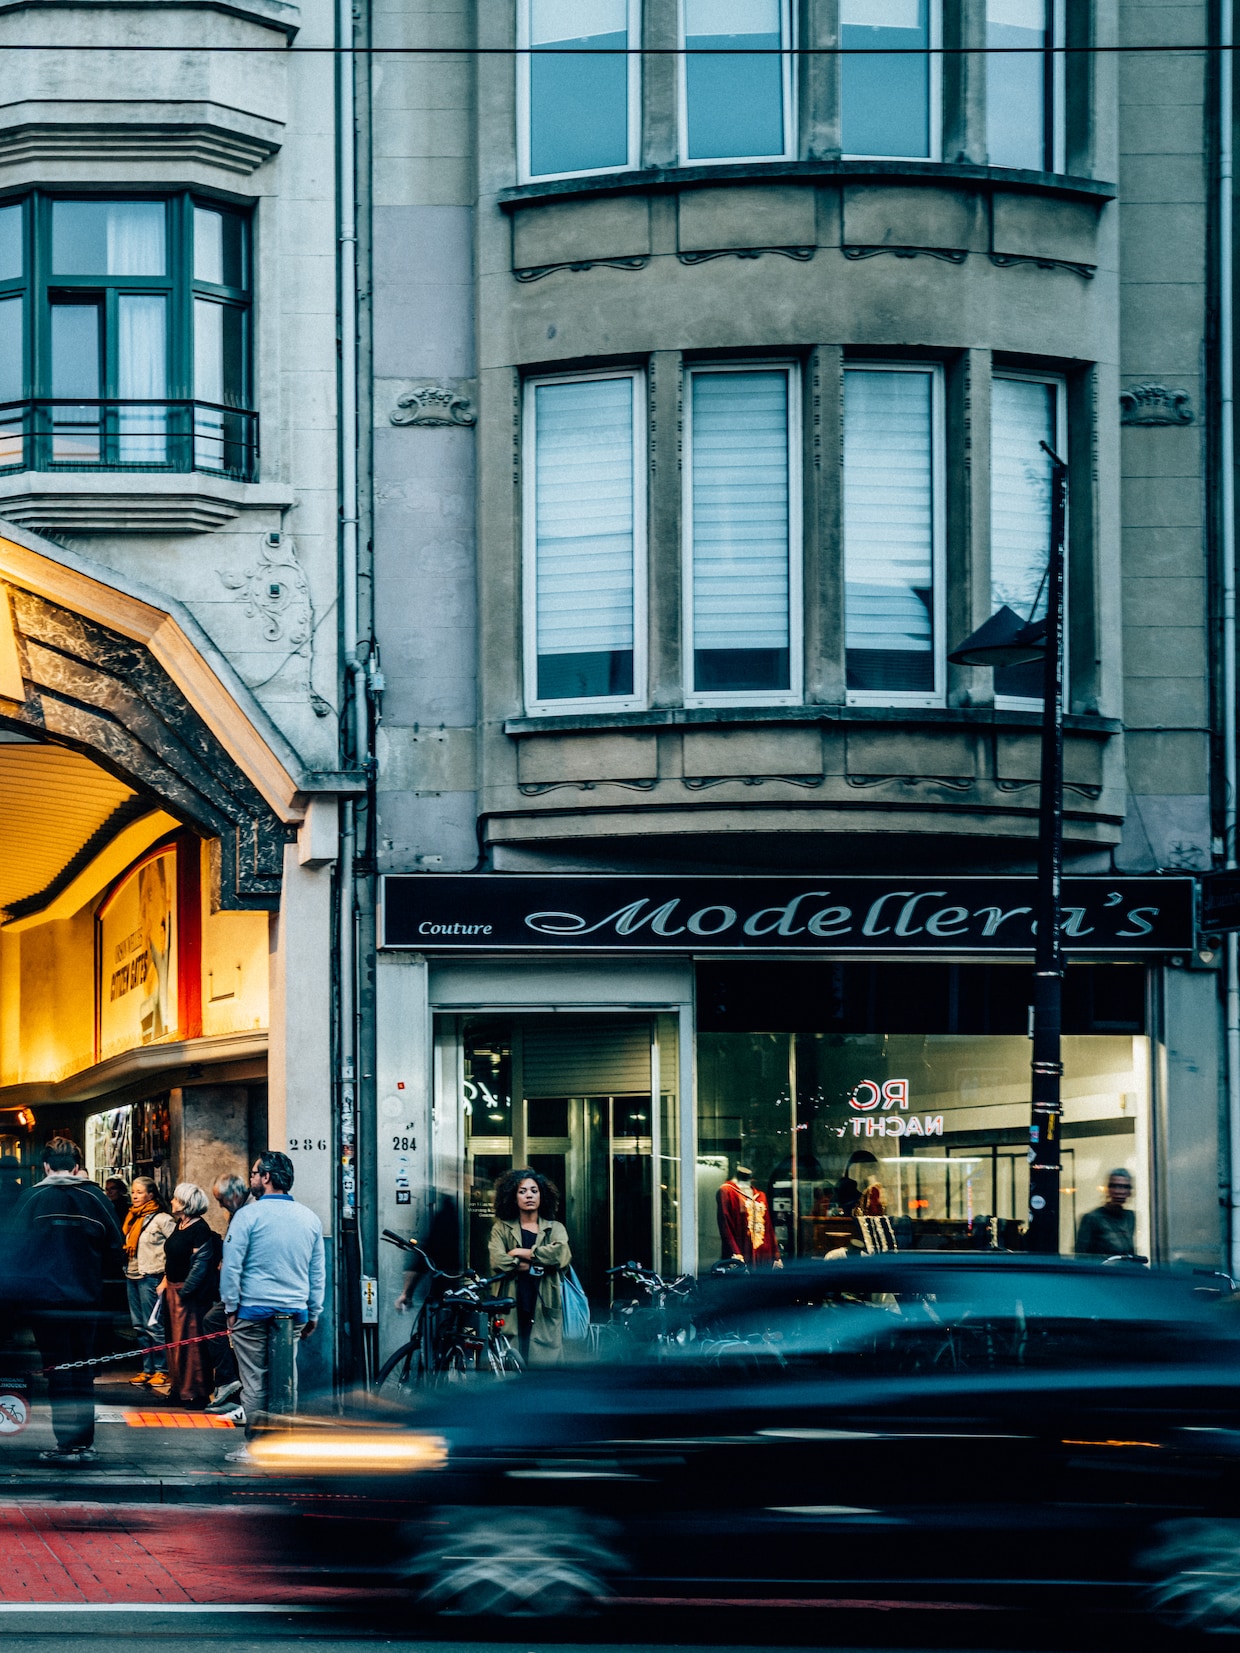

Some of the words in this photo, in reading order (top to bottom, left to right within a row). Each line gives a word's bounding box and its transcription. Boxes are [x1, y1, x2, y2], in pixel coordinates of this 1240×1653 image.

[418, 921, 493, 935] Couture
[289, 1139, 327, 1150] 286
[392, 1137, 417, 1150] 284
